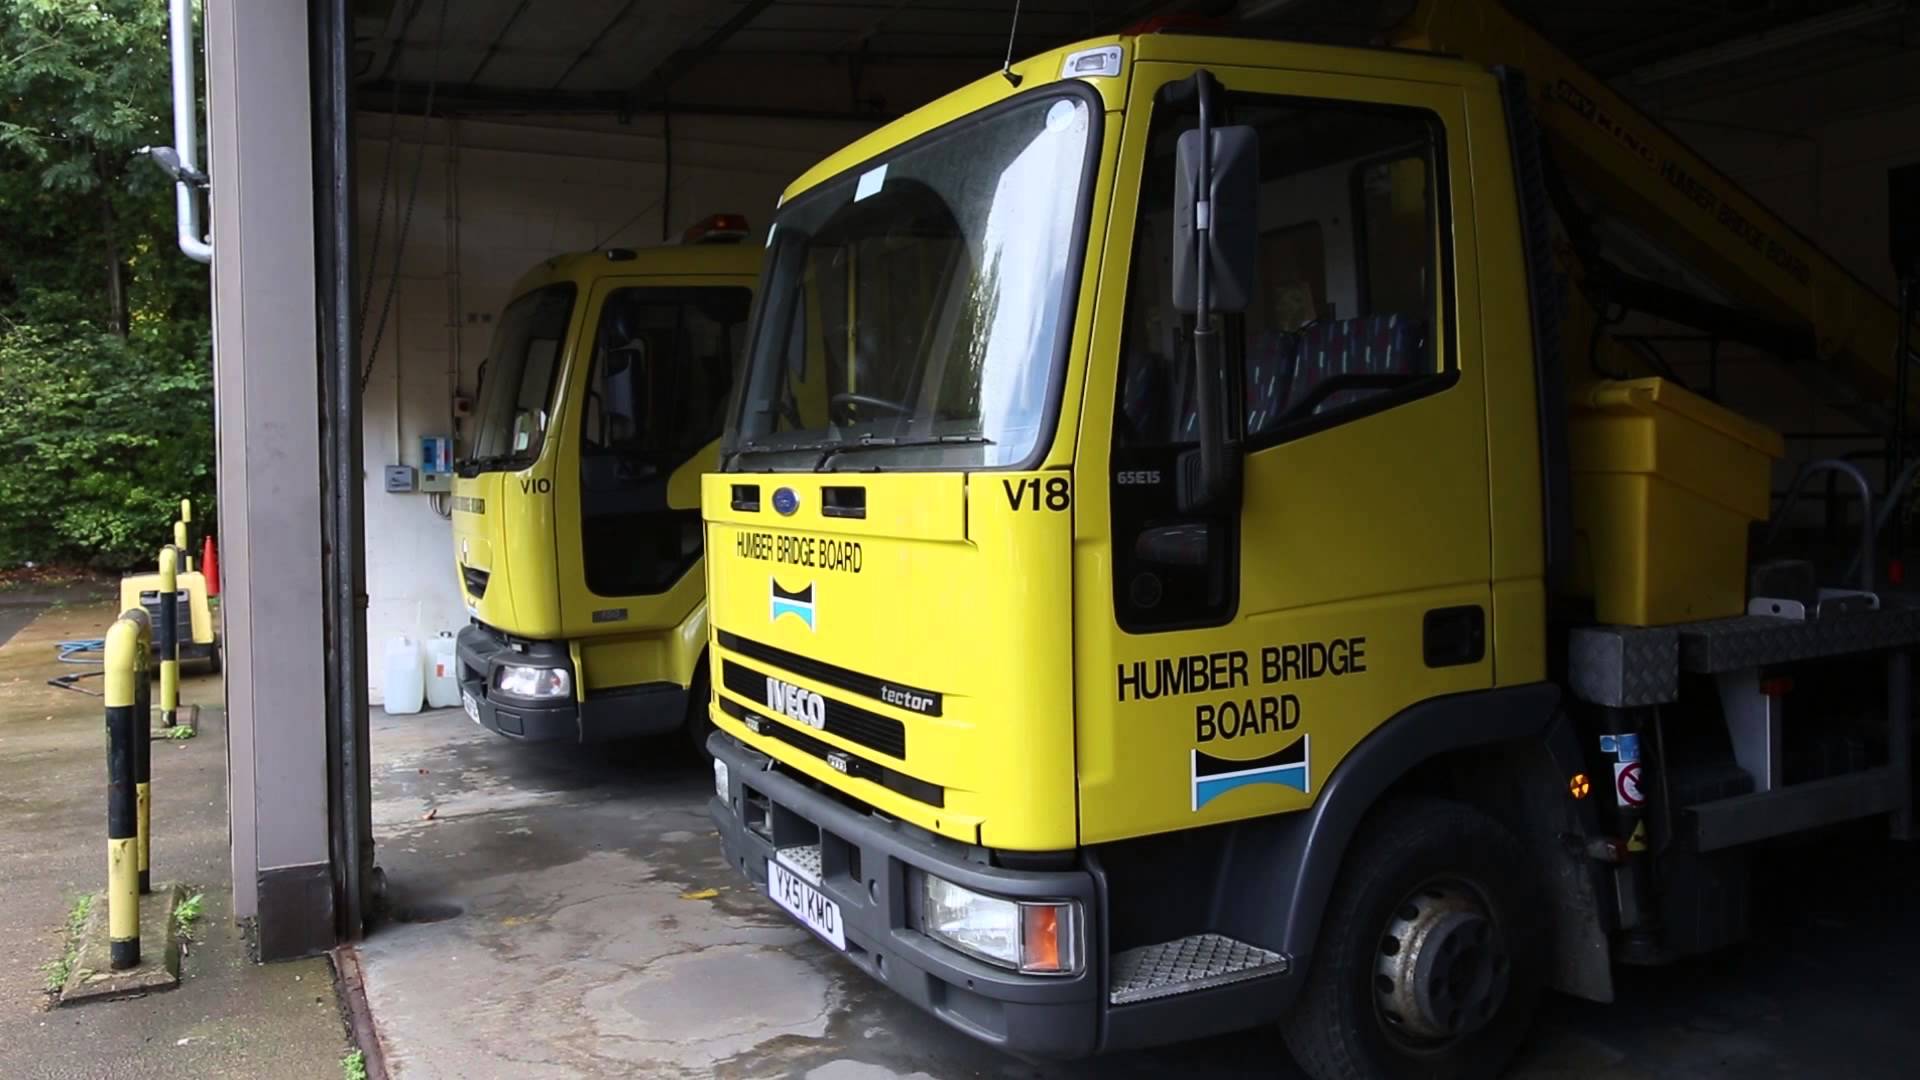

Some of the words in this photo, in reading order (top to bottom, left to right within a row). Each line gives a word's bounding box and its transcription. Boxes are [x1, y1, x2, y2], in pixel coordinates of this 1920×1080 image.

[1003, 477, 1070, 512] V18
[1117, 470, 1161, 485] 65E15
[736, 532, 773, 560] HUMBER
[776, 536, 815, 567] BRIDGE
[818, 542, 863, 573] BOARD
[1117, 650, 1249, 702] HUMBER
[1261, 637, 1367, 684] BRIDGE
[766, 677, 826, 731] IVECO
[881, 685, 933, 711] tector
[1196, 694, 1301, 743] BOARD
[775, 866, 805, 911] YX51
